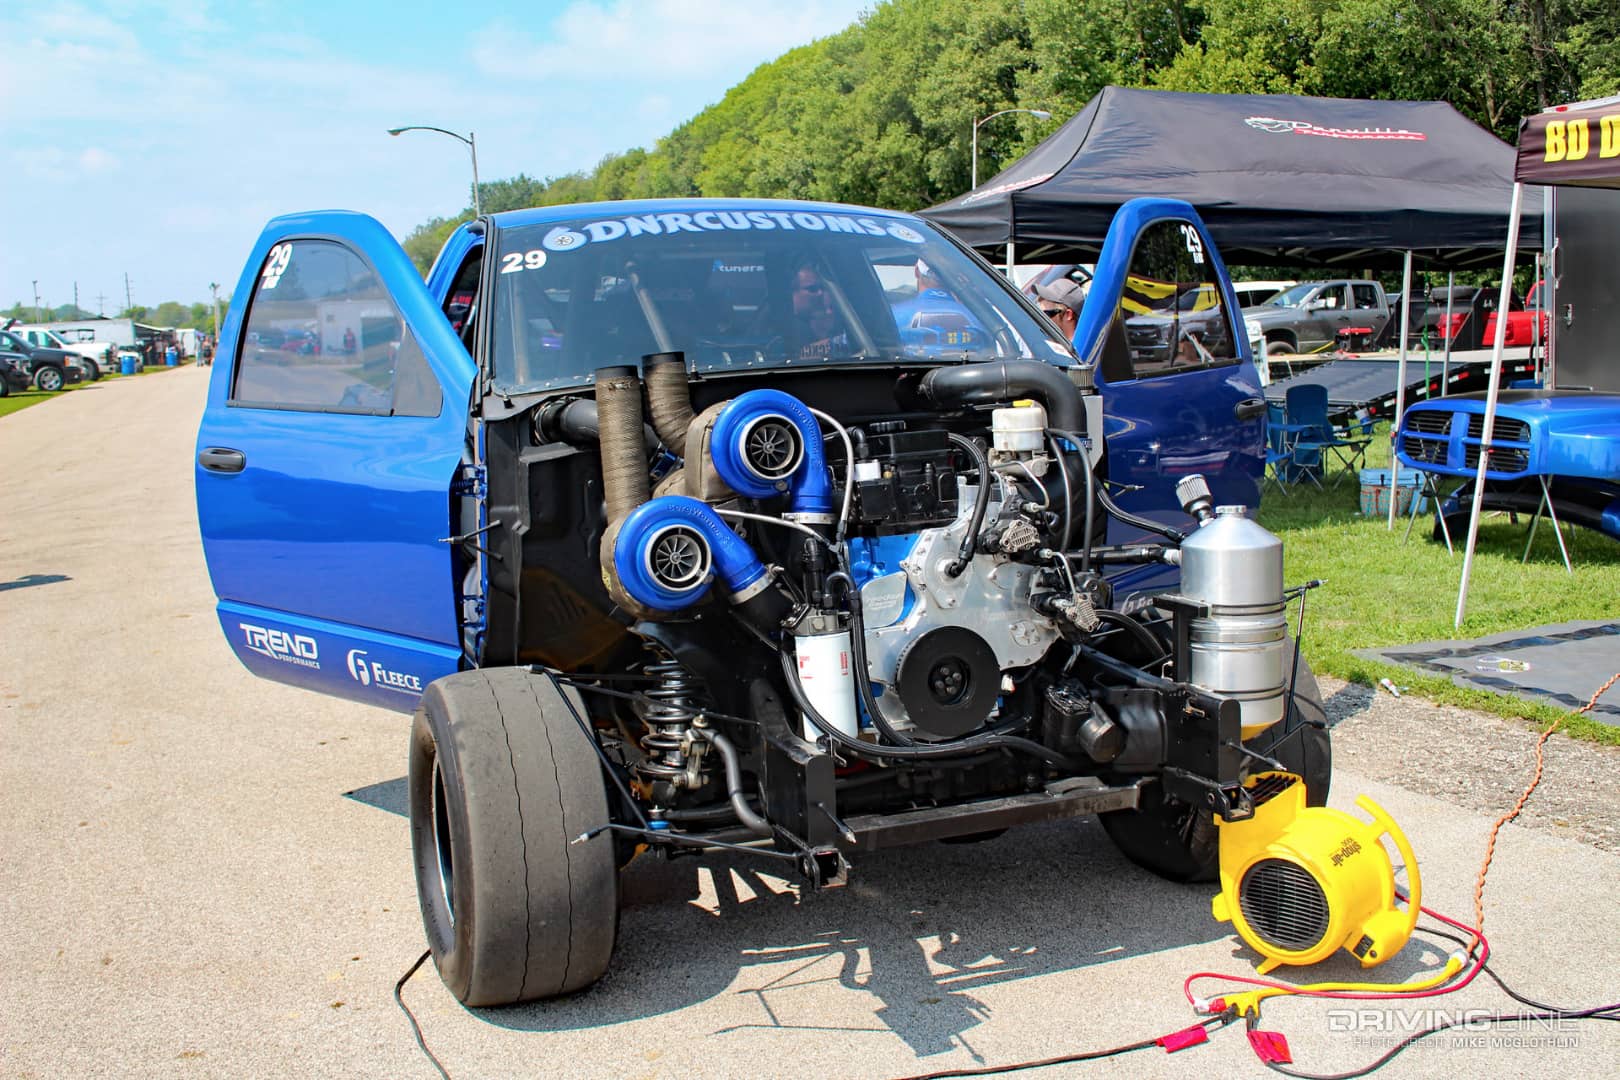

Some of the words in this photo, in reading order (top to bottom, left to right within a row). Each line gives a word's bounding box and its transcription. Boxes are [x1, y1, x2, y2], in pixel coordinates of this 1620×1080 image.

[1544, 118, 1589, 162] BD
[588, 212, 890, 243] DNRCUSTOMS
[1181, 224, 1202, 252] 29
[263, 243, 292, 277] 29
[501, 250, 547, 273] 29
[239, 623, 318, 660] TREND
